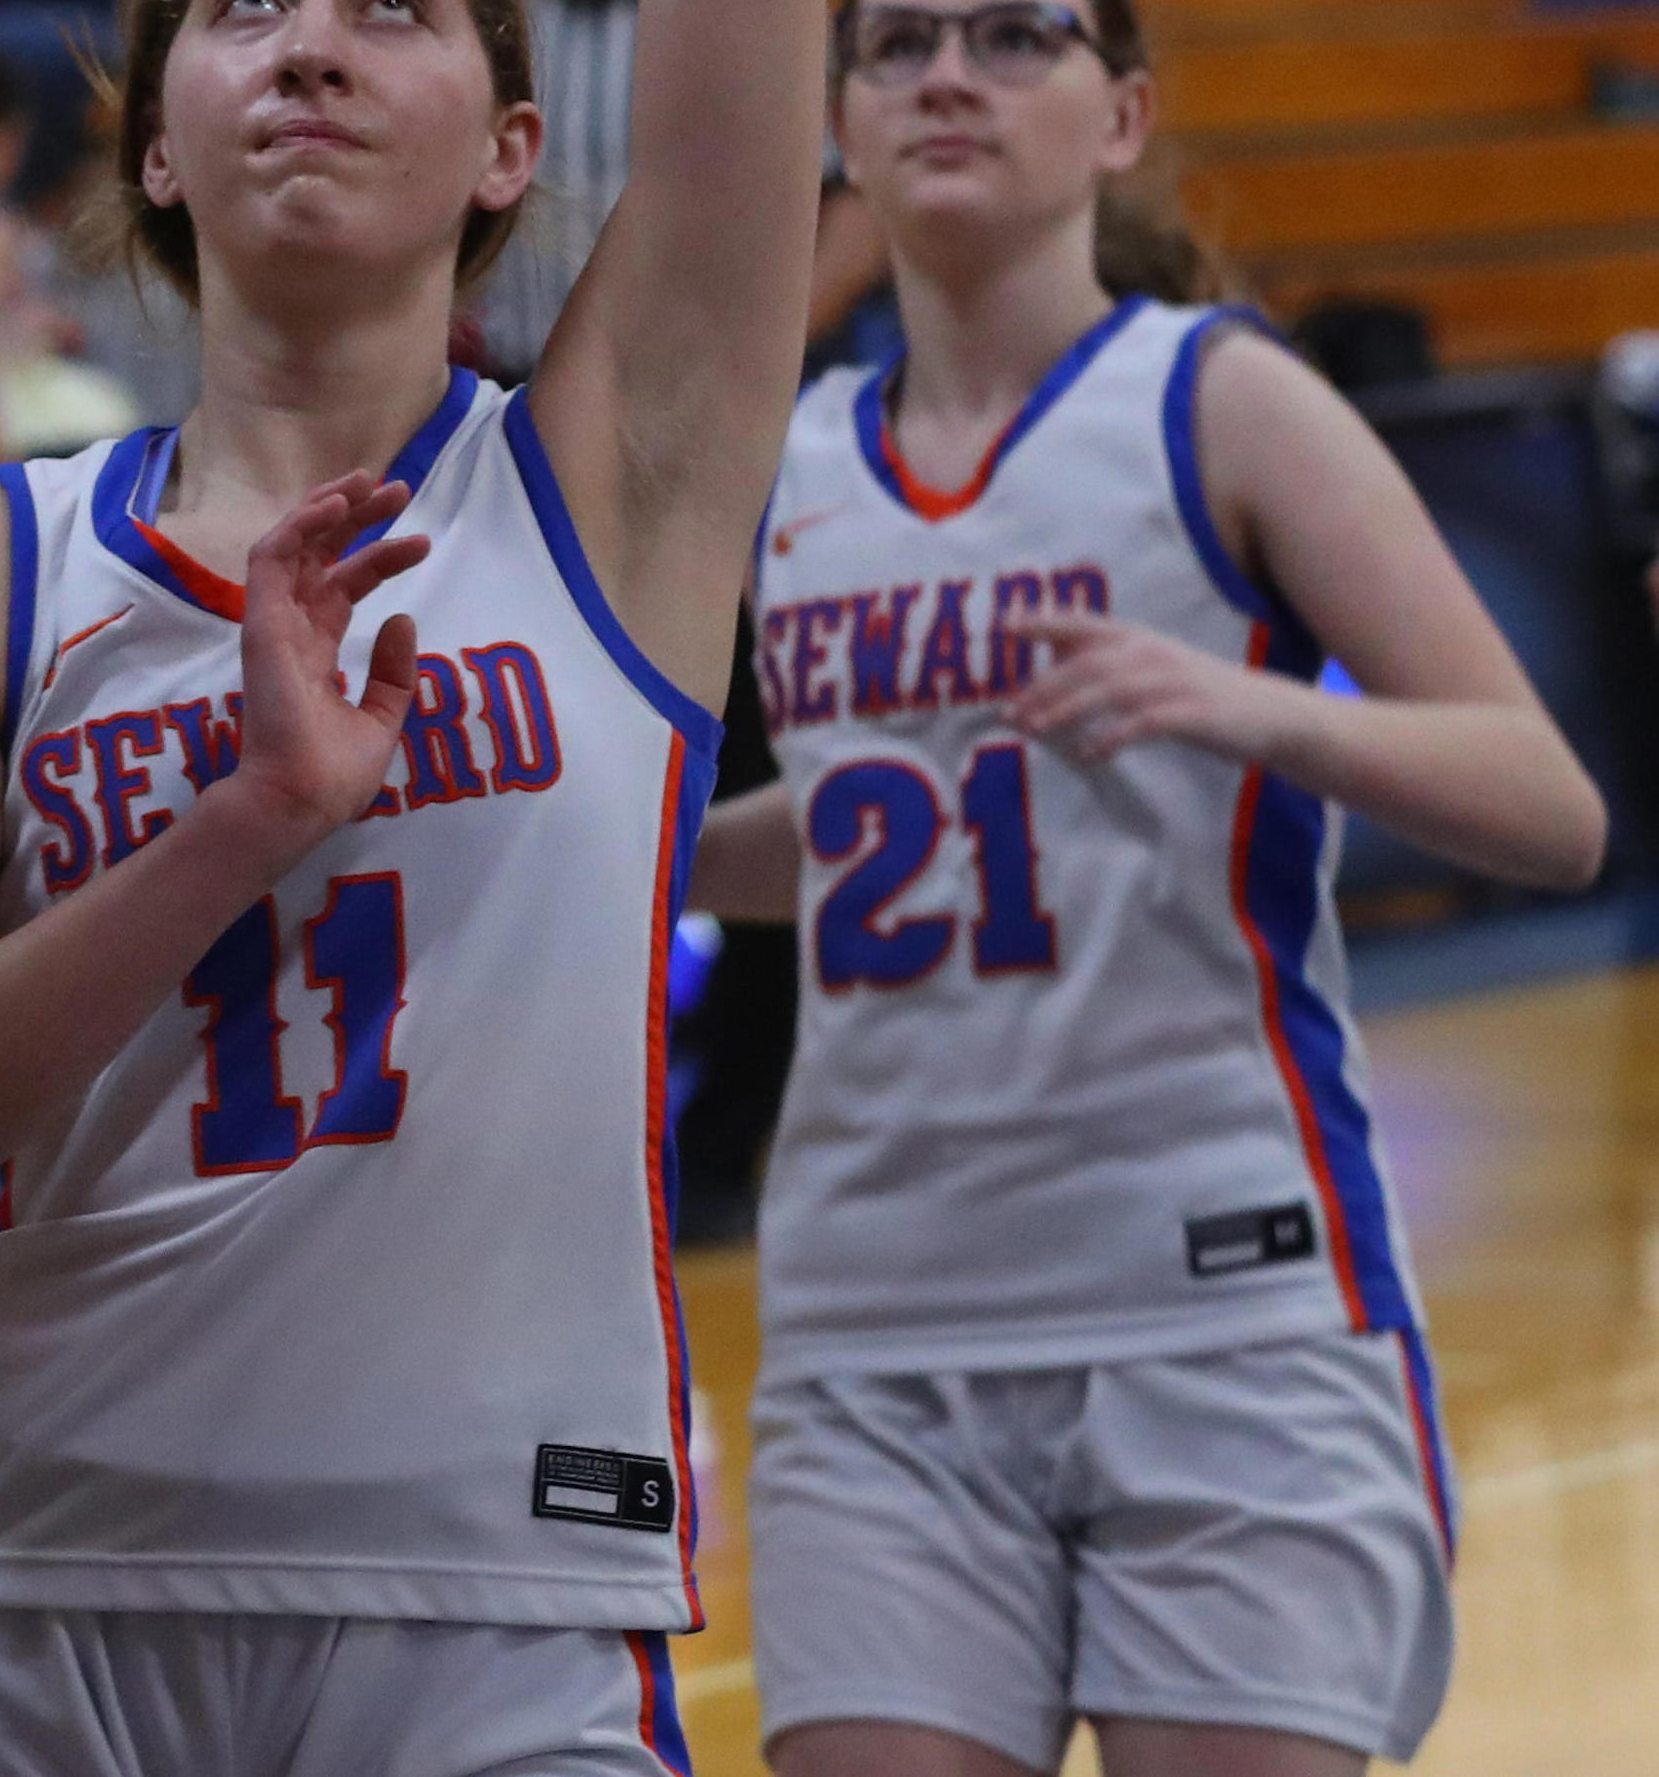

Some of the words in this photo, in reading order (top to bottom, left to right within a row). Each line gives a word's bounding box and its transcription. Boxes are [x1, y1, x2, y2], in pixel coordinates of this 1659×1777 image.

[21, 640, 562, 893] SERD
[807, 740, 1057, 997] 21
[182, 870, 407, 1177] 11
[641, 1480, 660, 1508] S
